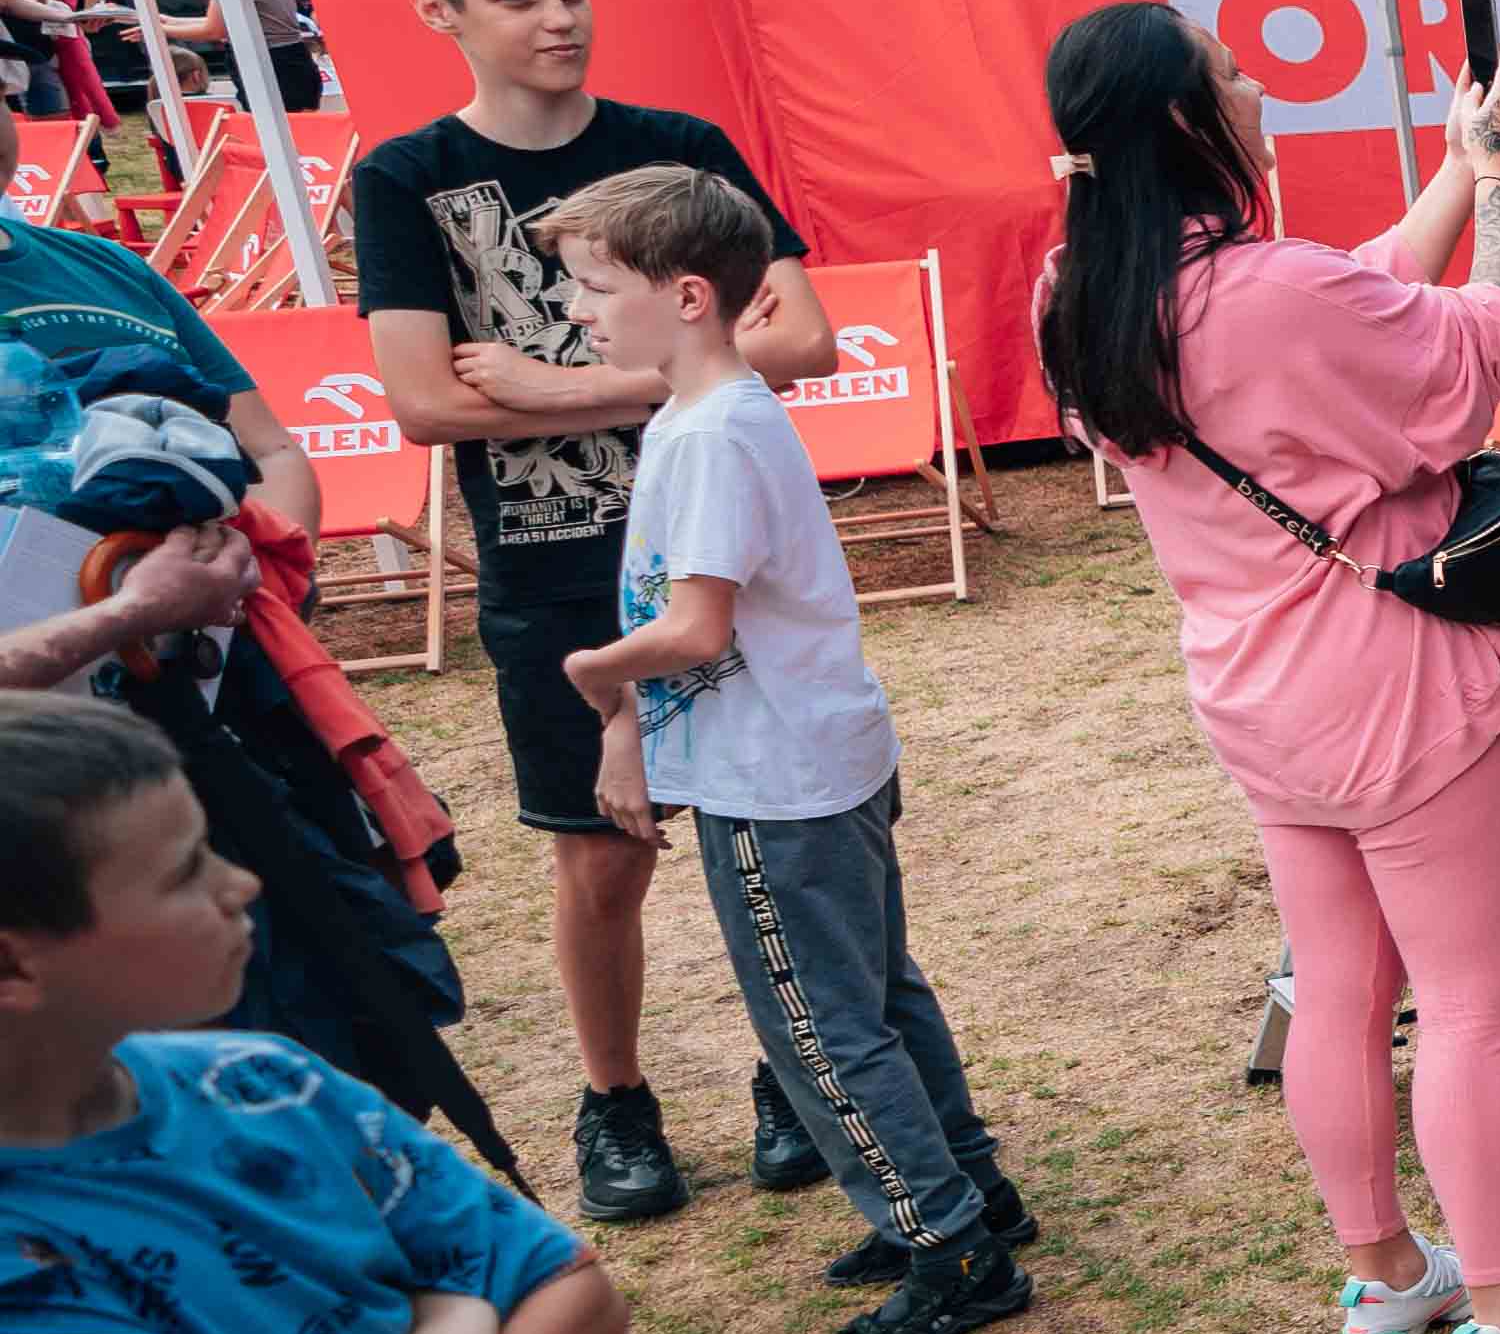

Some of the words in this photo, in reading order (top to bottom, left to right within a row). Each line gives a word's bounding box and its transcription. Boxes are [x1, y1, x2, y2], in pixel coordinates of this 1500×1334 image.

[519, 511, 567, 526] THREAT
[547, 524, 607, 542] ACCIDENT
[742, 872, 777, 932] PLAYER
[793, 1018, 831, 1072] PLAYER
[863, 1147, 905, 1198] PLAYER
